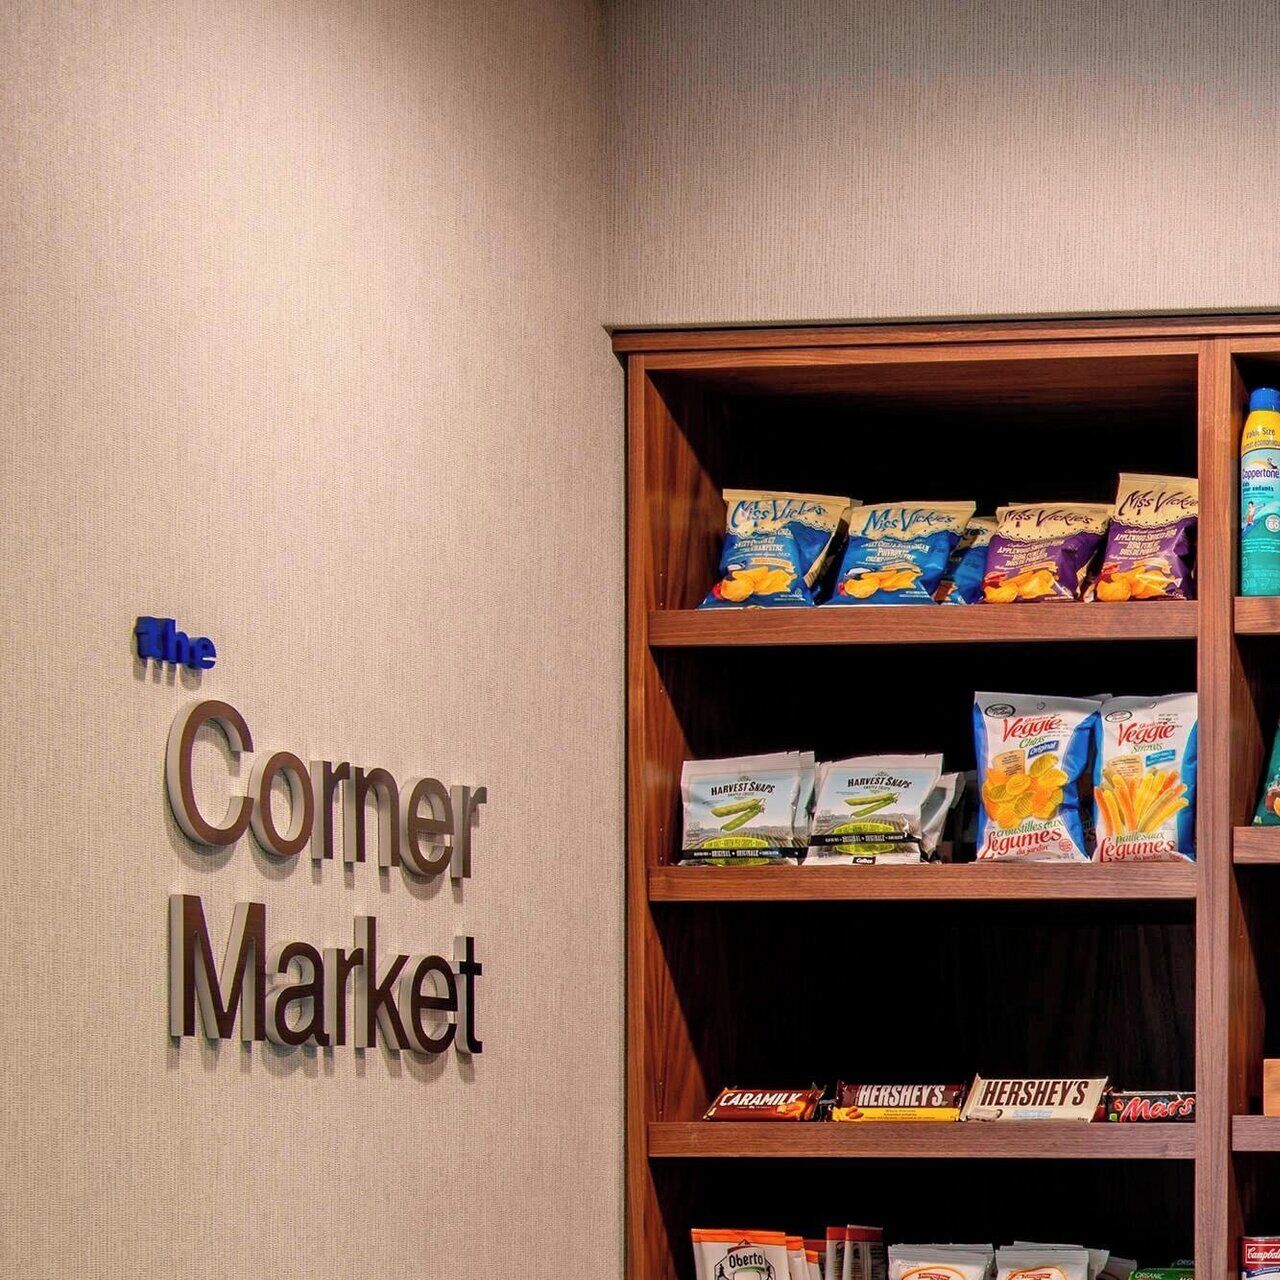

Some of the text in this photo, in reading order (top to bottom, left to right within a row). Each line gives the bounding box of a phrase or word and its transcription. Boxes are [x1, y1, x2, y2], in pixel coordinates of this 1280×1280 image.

[1262, 427, 1275, 436] Size
[1119, 490, 1198, 516] Miss Vickie
[862, 509, 955, 535] Miss Vickie's
[1036, 509, 1092, 527] Vickie's
[1002, 717, 1063, 743] Veggie
[1118, 723, 1175, 746] Veggie
[1030, 742, 1057, 755] Original
[166, 700, 487, 879] Corner
[711, 781, 776, 797] HARVEST SNAPS
[848, 776, 912, 788] HARVEST SNAPS
[169, 894, 483, 1054] Market
[720, 1092, 802, 1106] CARAMILK
[857, 1084, 946, 1107] HERSHEY'S
[980, 1080, 1089, 1107] HERSHEY'S
[1120, 1096, 1194, 1123] Mars
[729, 1252, 764, 1268] Oberto
